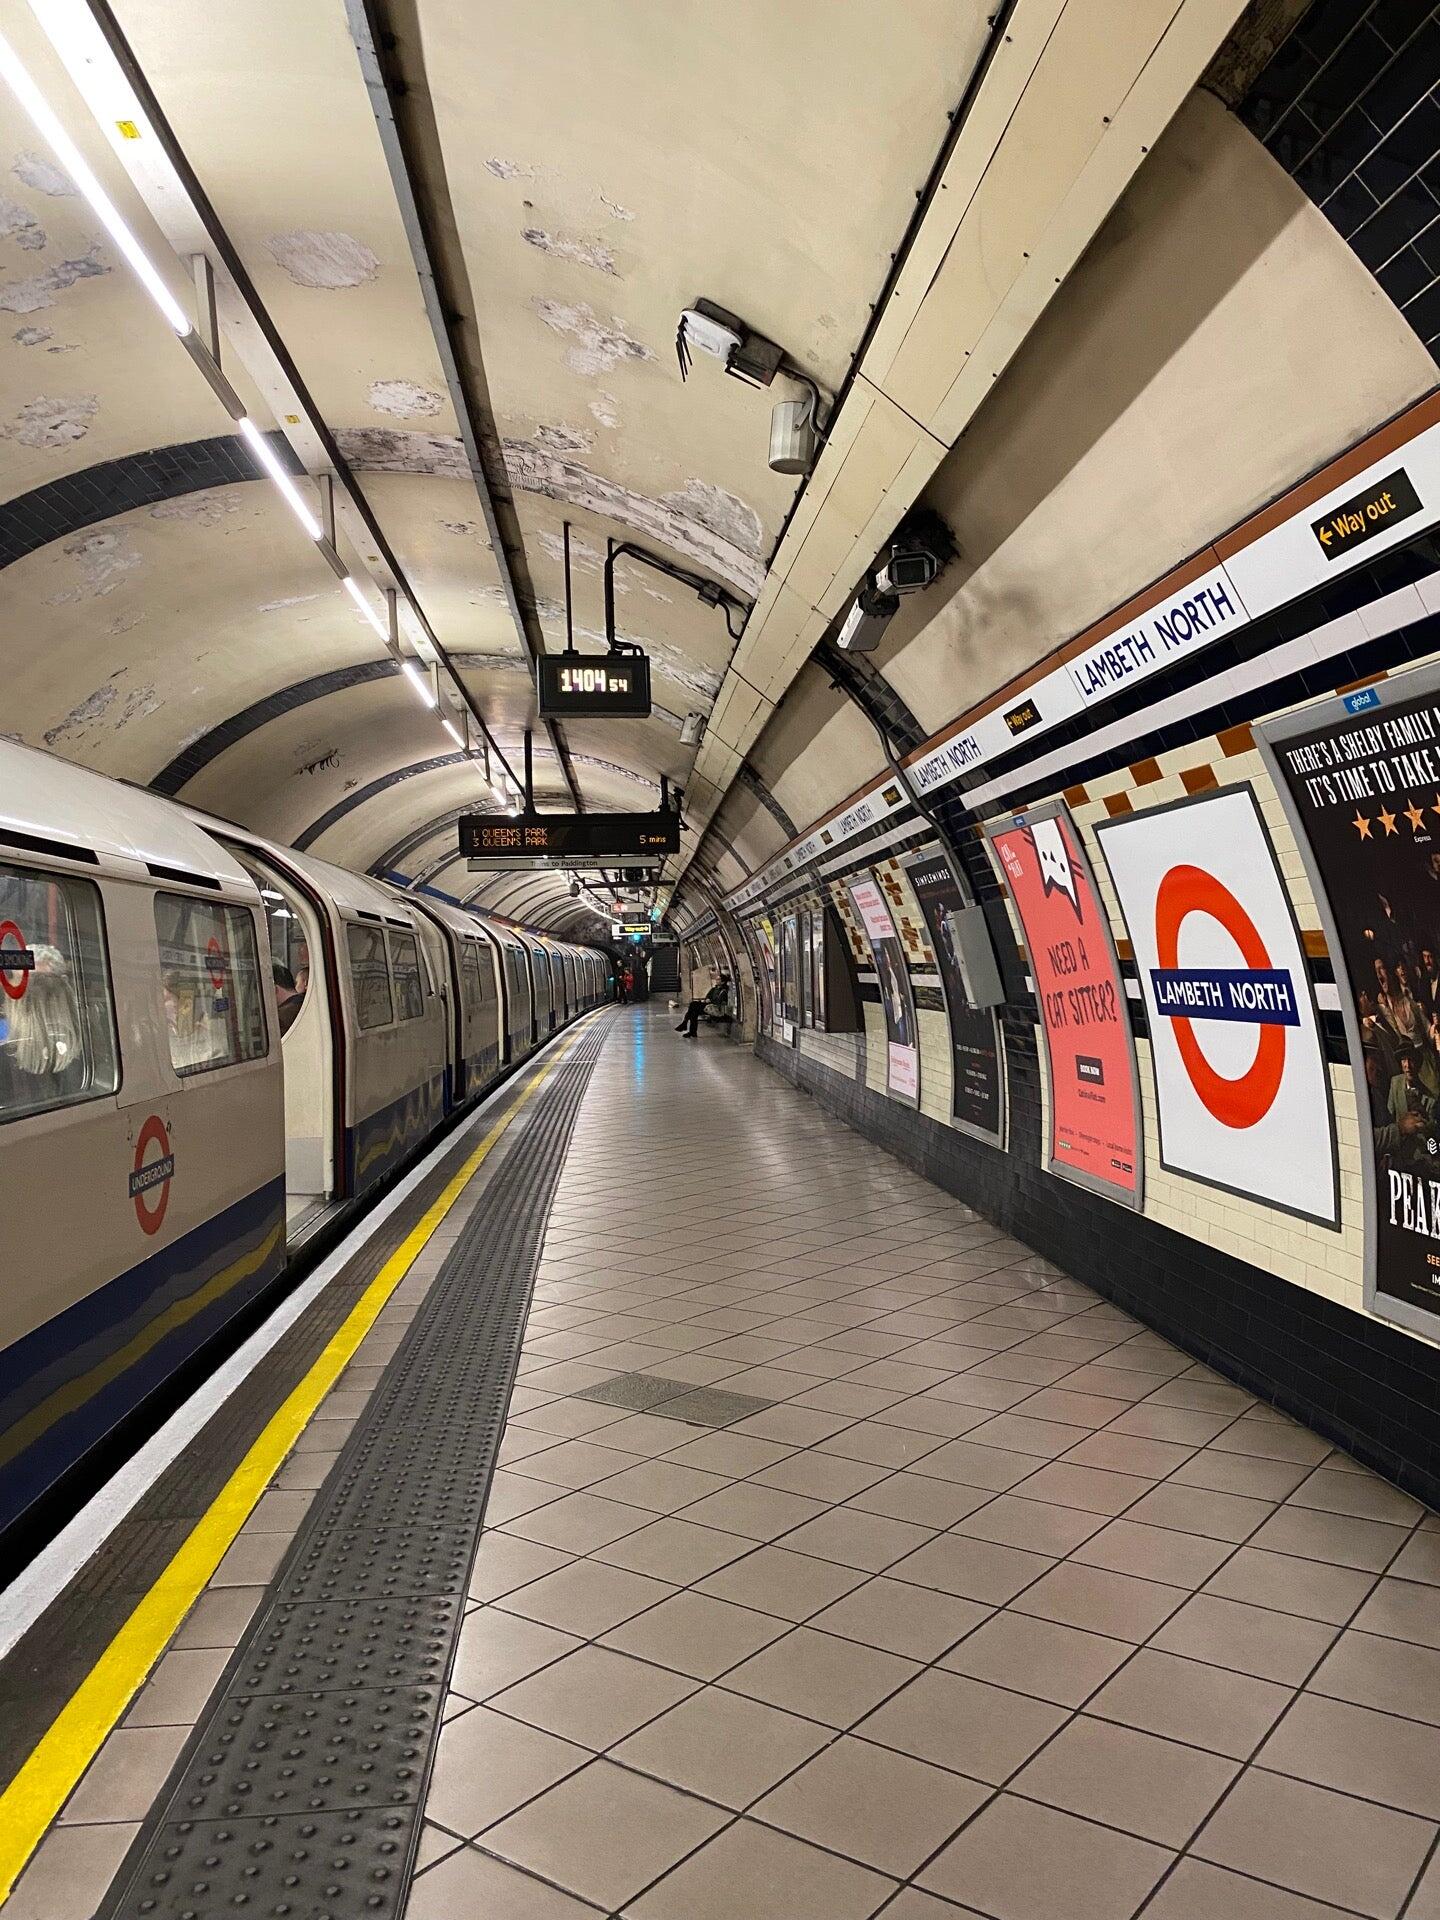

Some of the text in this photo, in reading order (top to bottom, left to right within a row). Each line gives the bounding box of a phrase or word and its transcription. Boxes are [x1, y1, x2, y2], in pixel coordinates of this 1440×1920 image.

[1331, 492, 1396, 539] Way out
[1075, 581, 1236, 696] LAMBETH NORTH
[561, 669, 628, 692] 1404 54
[1351, 693, 1372, 710] global
[1286, 741, 1333, 775] THERE'S
[1329, 738, 1344, 763] A
[1339, 723, 1387, 761] SHELBY
[1383, 710, 1436, 748] FAMILY
[913, 736, 982, 788] LAMBETH NORTH
[1305, 749, 1440, 808] IT'S TIME TO TAKE
[482, 828, 522, 837] QUEEN'S
[525, 828, 548, 837] PARK
[482, 837, 522, 847] QUEEN'S
[525, 837, 549, 846] PARK
[639, 835, 646, 844] 5
[649, 836, 667, 844] mins
[561, 860, 598, 869] Paddington
[1047, 937, 1090, 977] NEED A
[1046, 979, 1118, 1029] CAT SITTER?
[1156, 981, 1291, 1012] LAMBETH NORTH
[131, 1160, 172, 1191] UNDERGROUND
